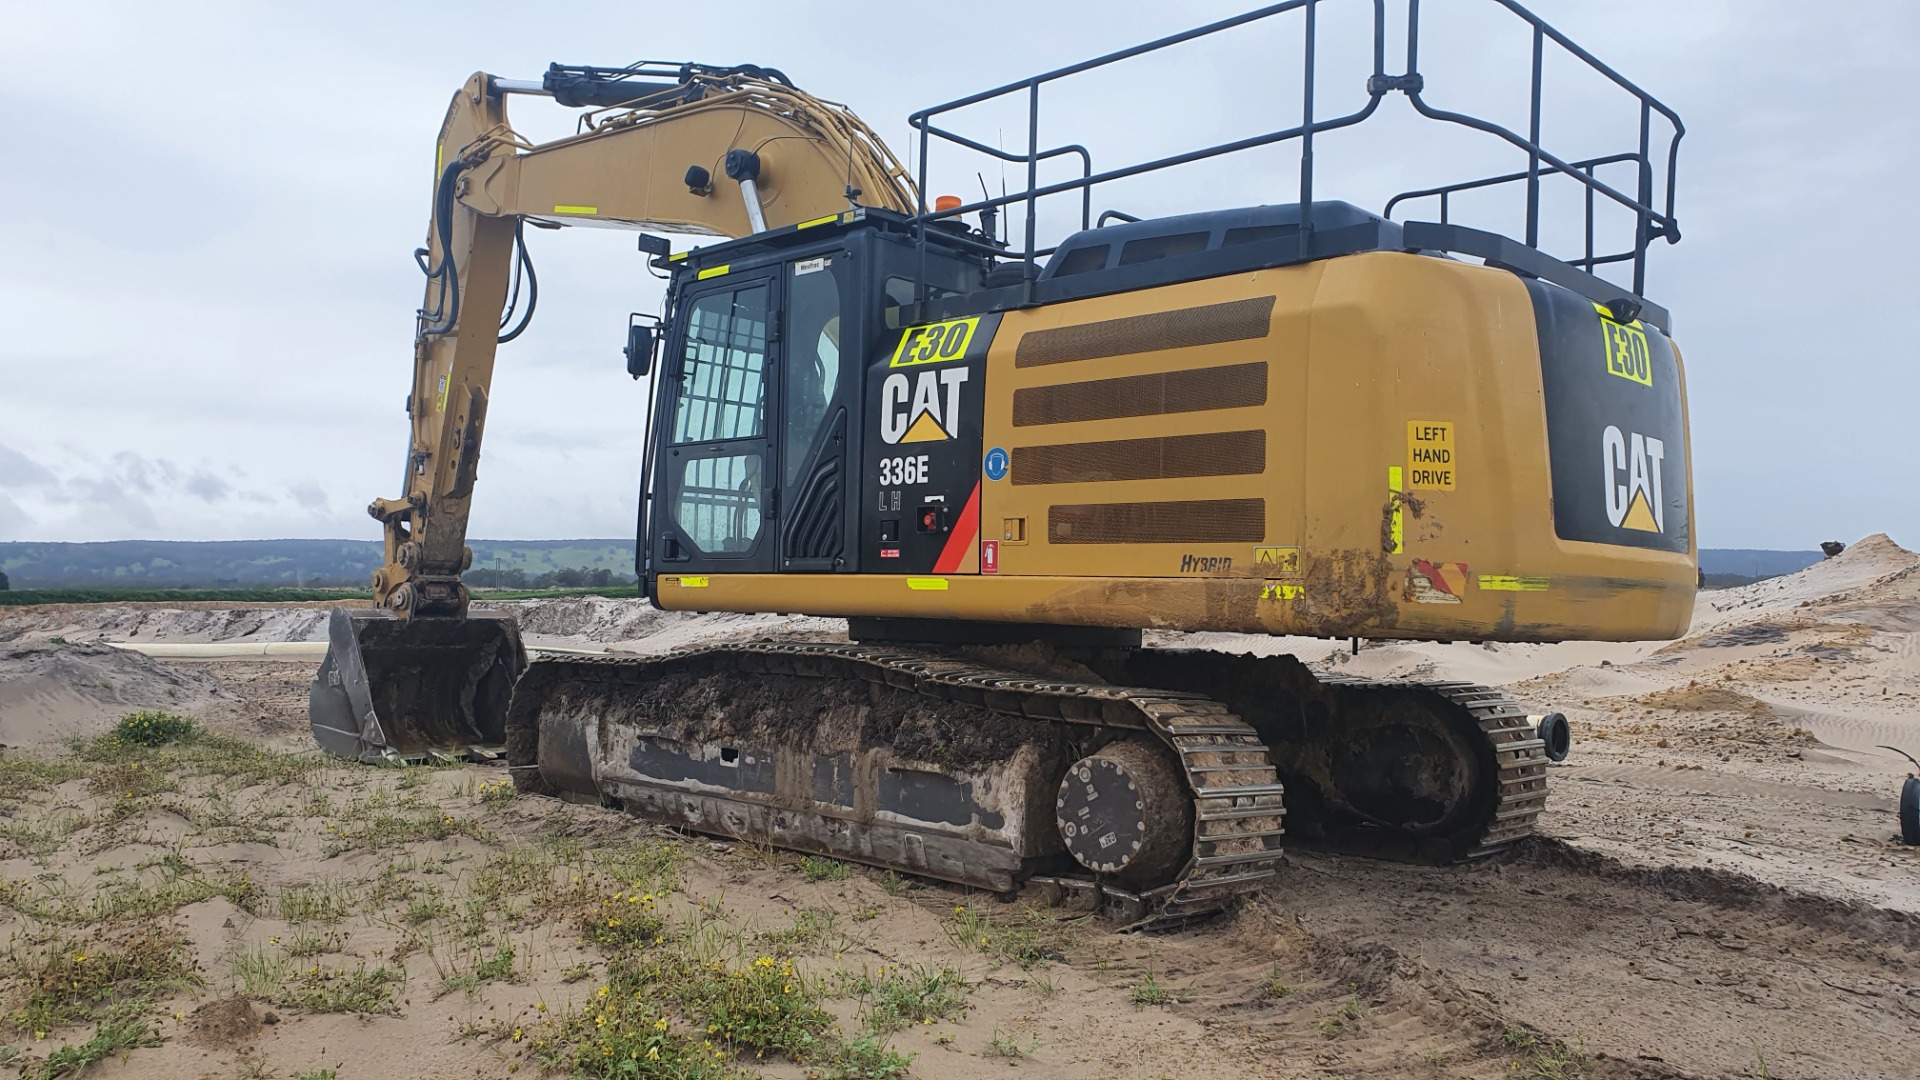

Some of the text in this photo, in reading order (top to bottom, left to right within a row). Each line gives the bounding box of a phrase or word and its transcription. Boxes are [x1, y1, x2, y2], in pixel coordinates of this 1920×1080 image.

[897, 322, 970, 364] E30
[1606, 323, 1648, 381] E30
[880, 367, 969, 444] CAT
[1415, 426, 1447, 441] LEFT
[879, 455, 929, 486] 336E
[1413, 448, 1450, 463] HAND
[1412, 470, 1452, 485] DRIVE
[1602, 425, 1664, 534] CAT
